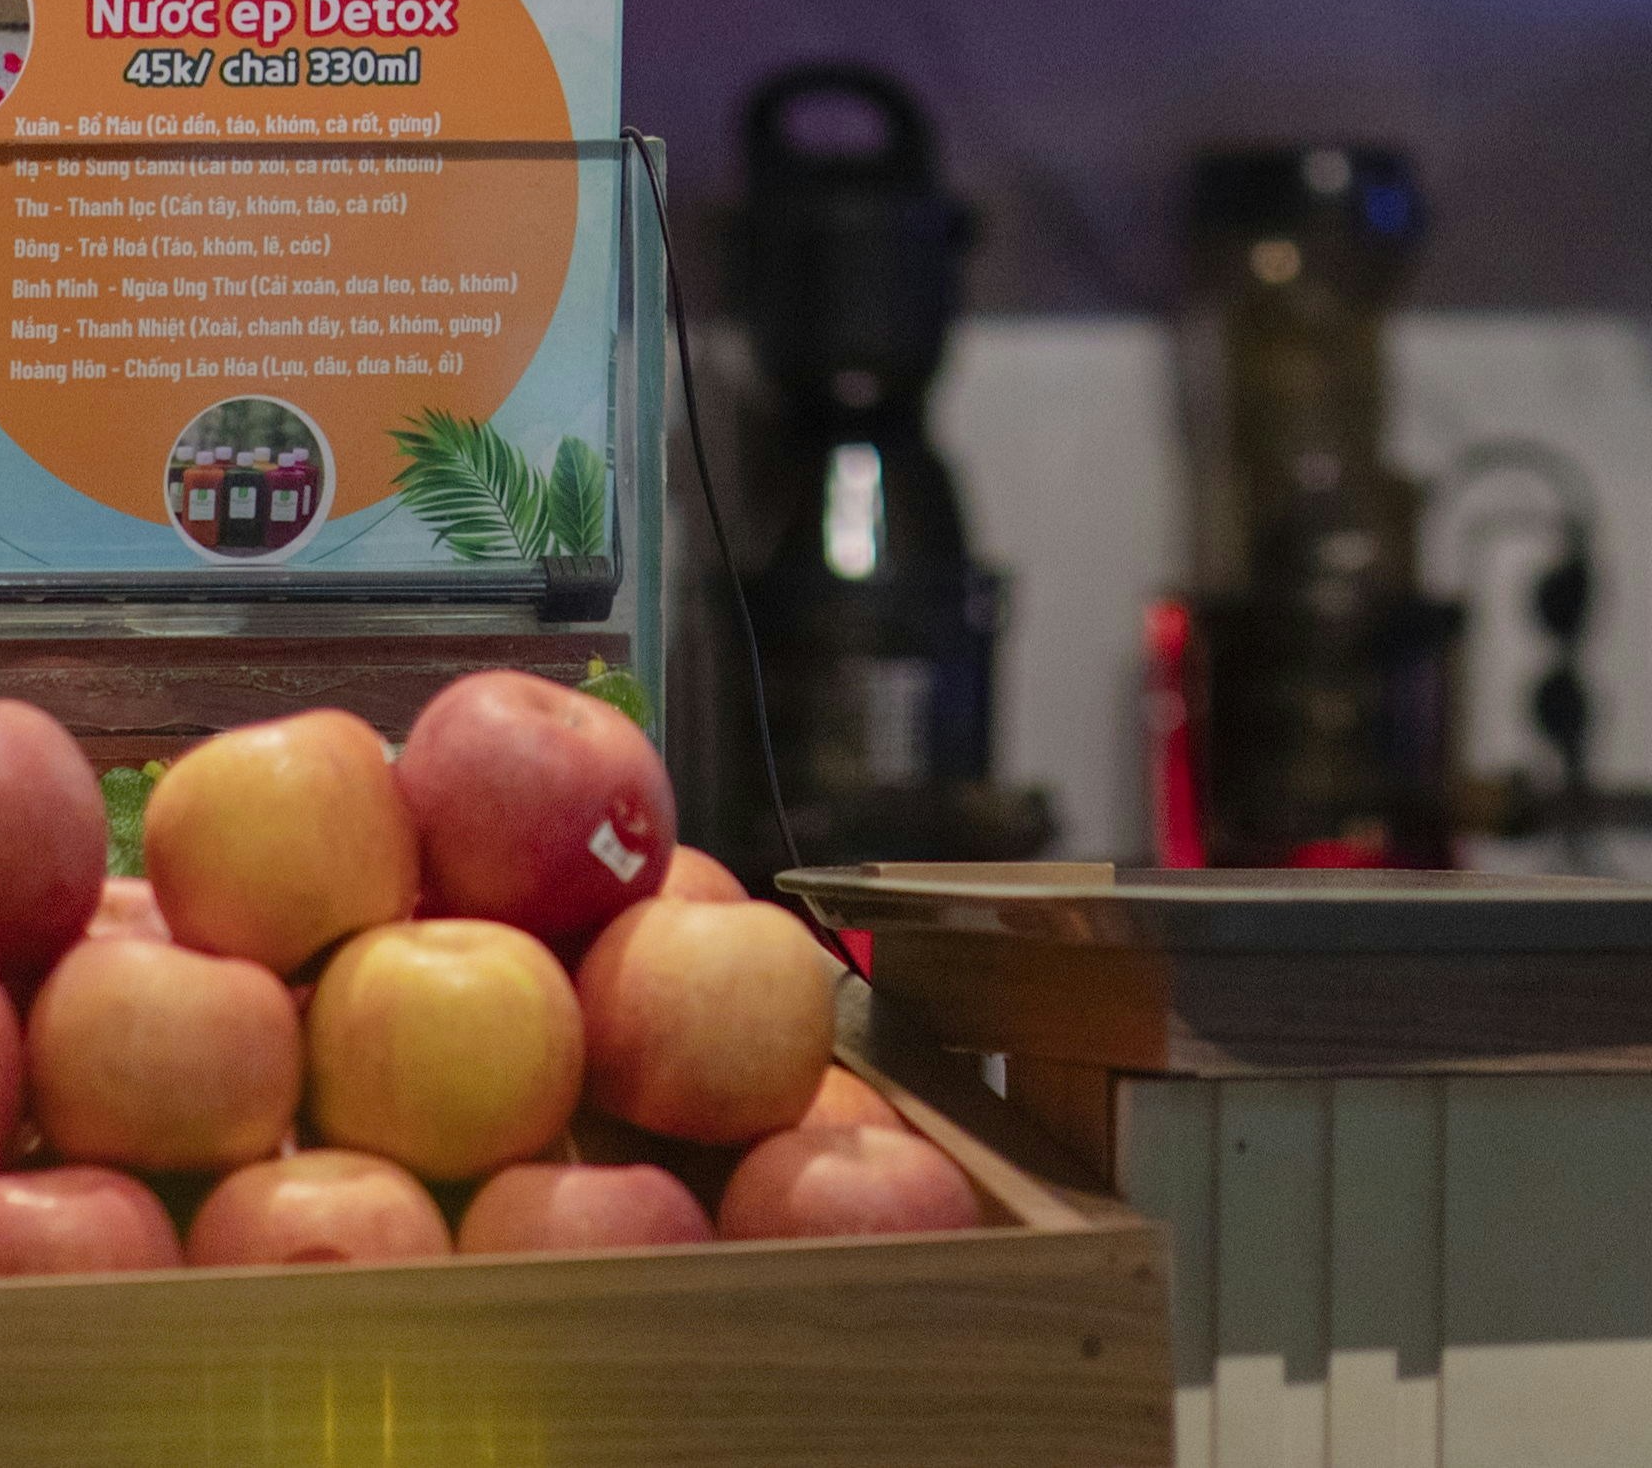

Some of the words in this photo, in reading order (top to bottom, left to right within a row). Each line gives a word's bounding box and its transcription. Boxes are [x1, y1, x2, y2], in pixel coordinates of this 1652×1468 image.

[127, 50, 210, 86] 45k/
[221, 50, 298, 84] chai
[307, 52, 419, 84] 330ml
